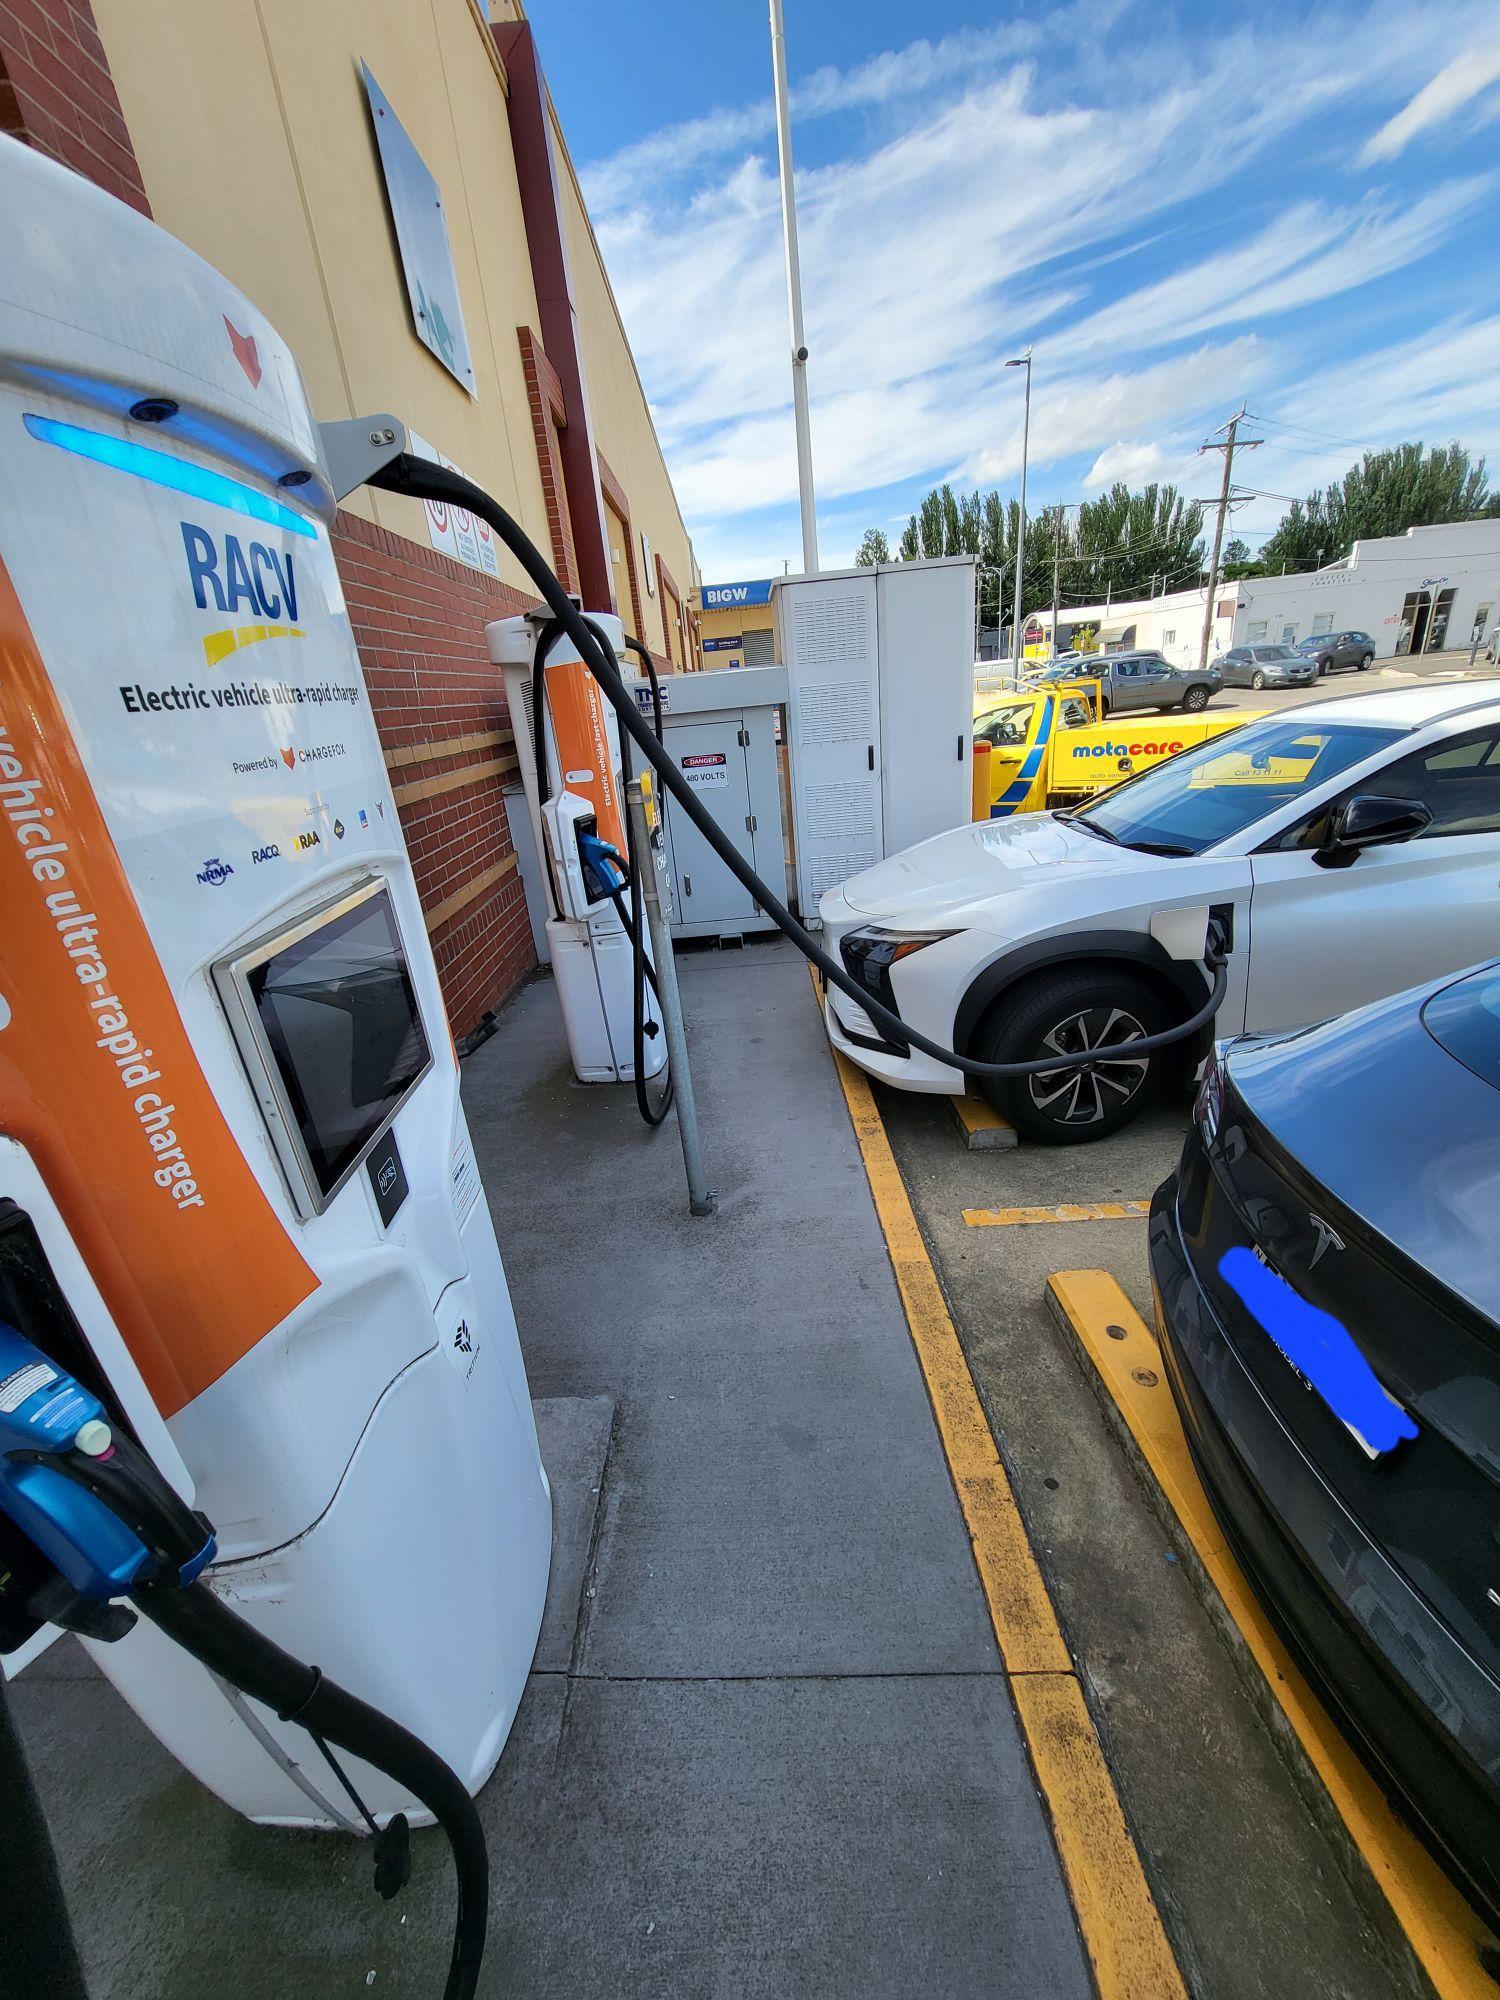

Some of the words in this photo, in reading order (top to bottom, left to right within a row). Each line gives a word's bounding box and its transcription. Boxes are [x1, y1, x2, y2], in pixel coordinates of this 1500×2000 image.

[180, 521, 298, 622] RACV
[706, 587, 748, 604] BIGW
[119, 682, 210, 713] Electric
[211, 682, 272, 708] vehicle
[271, 682, 331, 707] ultra-rapid
[332, 683, 360, 705] charger
[588, 688, 598, 722] charger
[593, 722, 601, 742] fast
[233, 756, 268, 774] Powered
[268, 756, 278, 771] by
[298, 743, 345, 763] CHARGEFOX
[596, 743, 607, 773] vehicle
[1072, 741, 1184, 757] motacare
[690, 757, 717, 765] DANGER
[700, 771, 726, 780] VOLTS
[602, 774, 611, 806] Electric
[299, 830, 321, 849] RAA
[251, 844, 280, 864] RACQ
[196, 864, 235, 885] NRMA
[46, 890, 161, 1089] ultra-rapid
[134, 1093, 205, 1210] charger
[1303, 1379, 1313, 1391] 3
